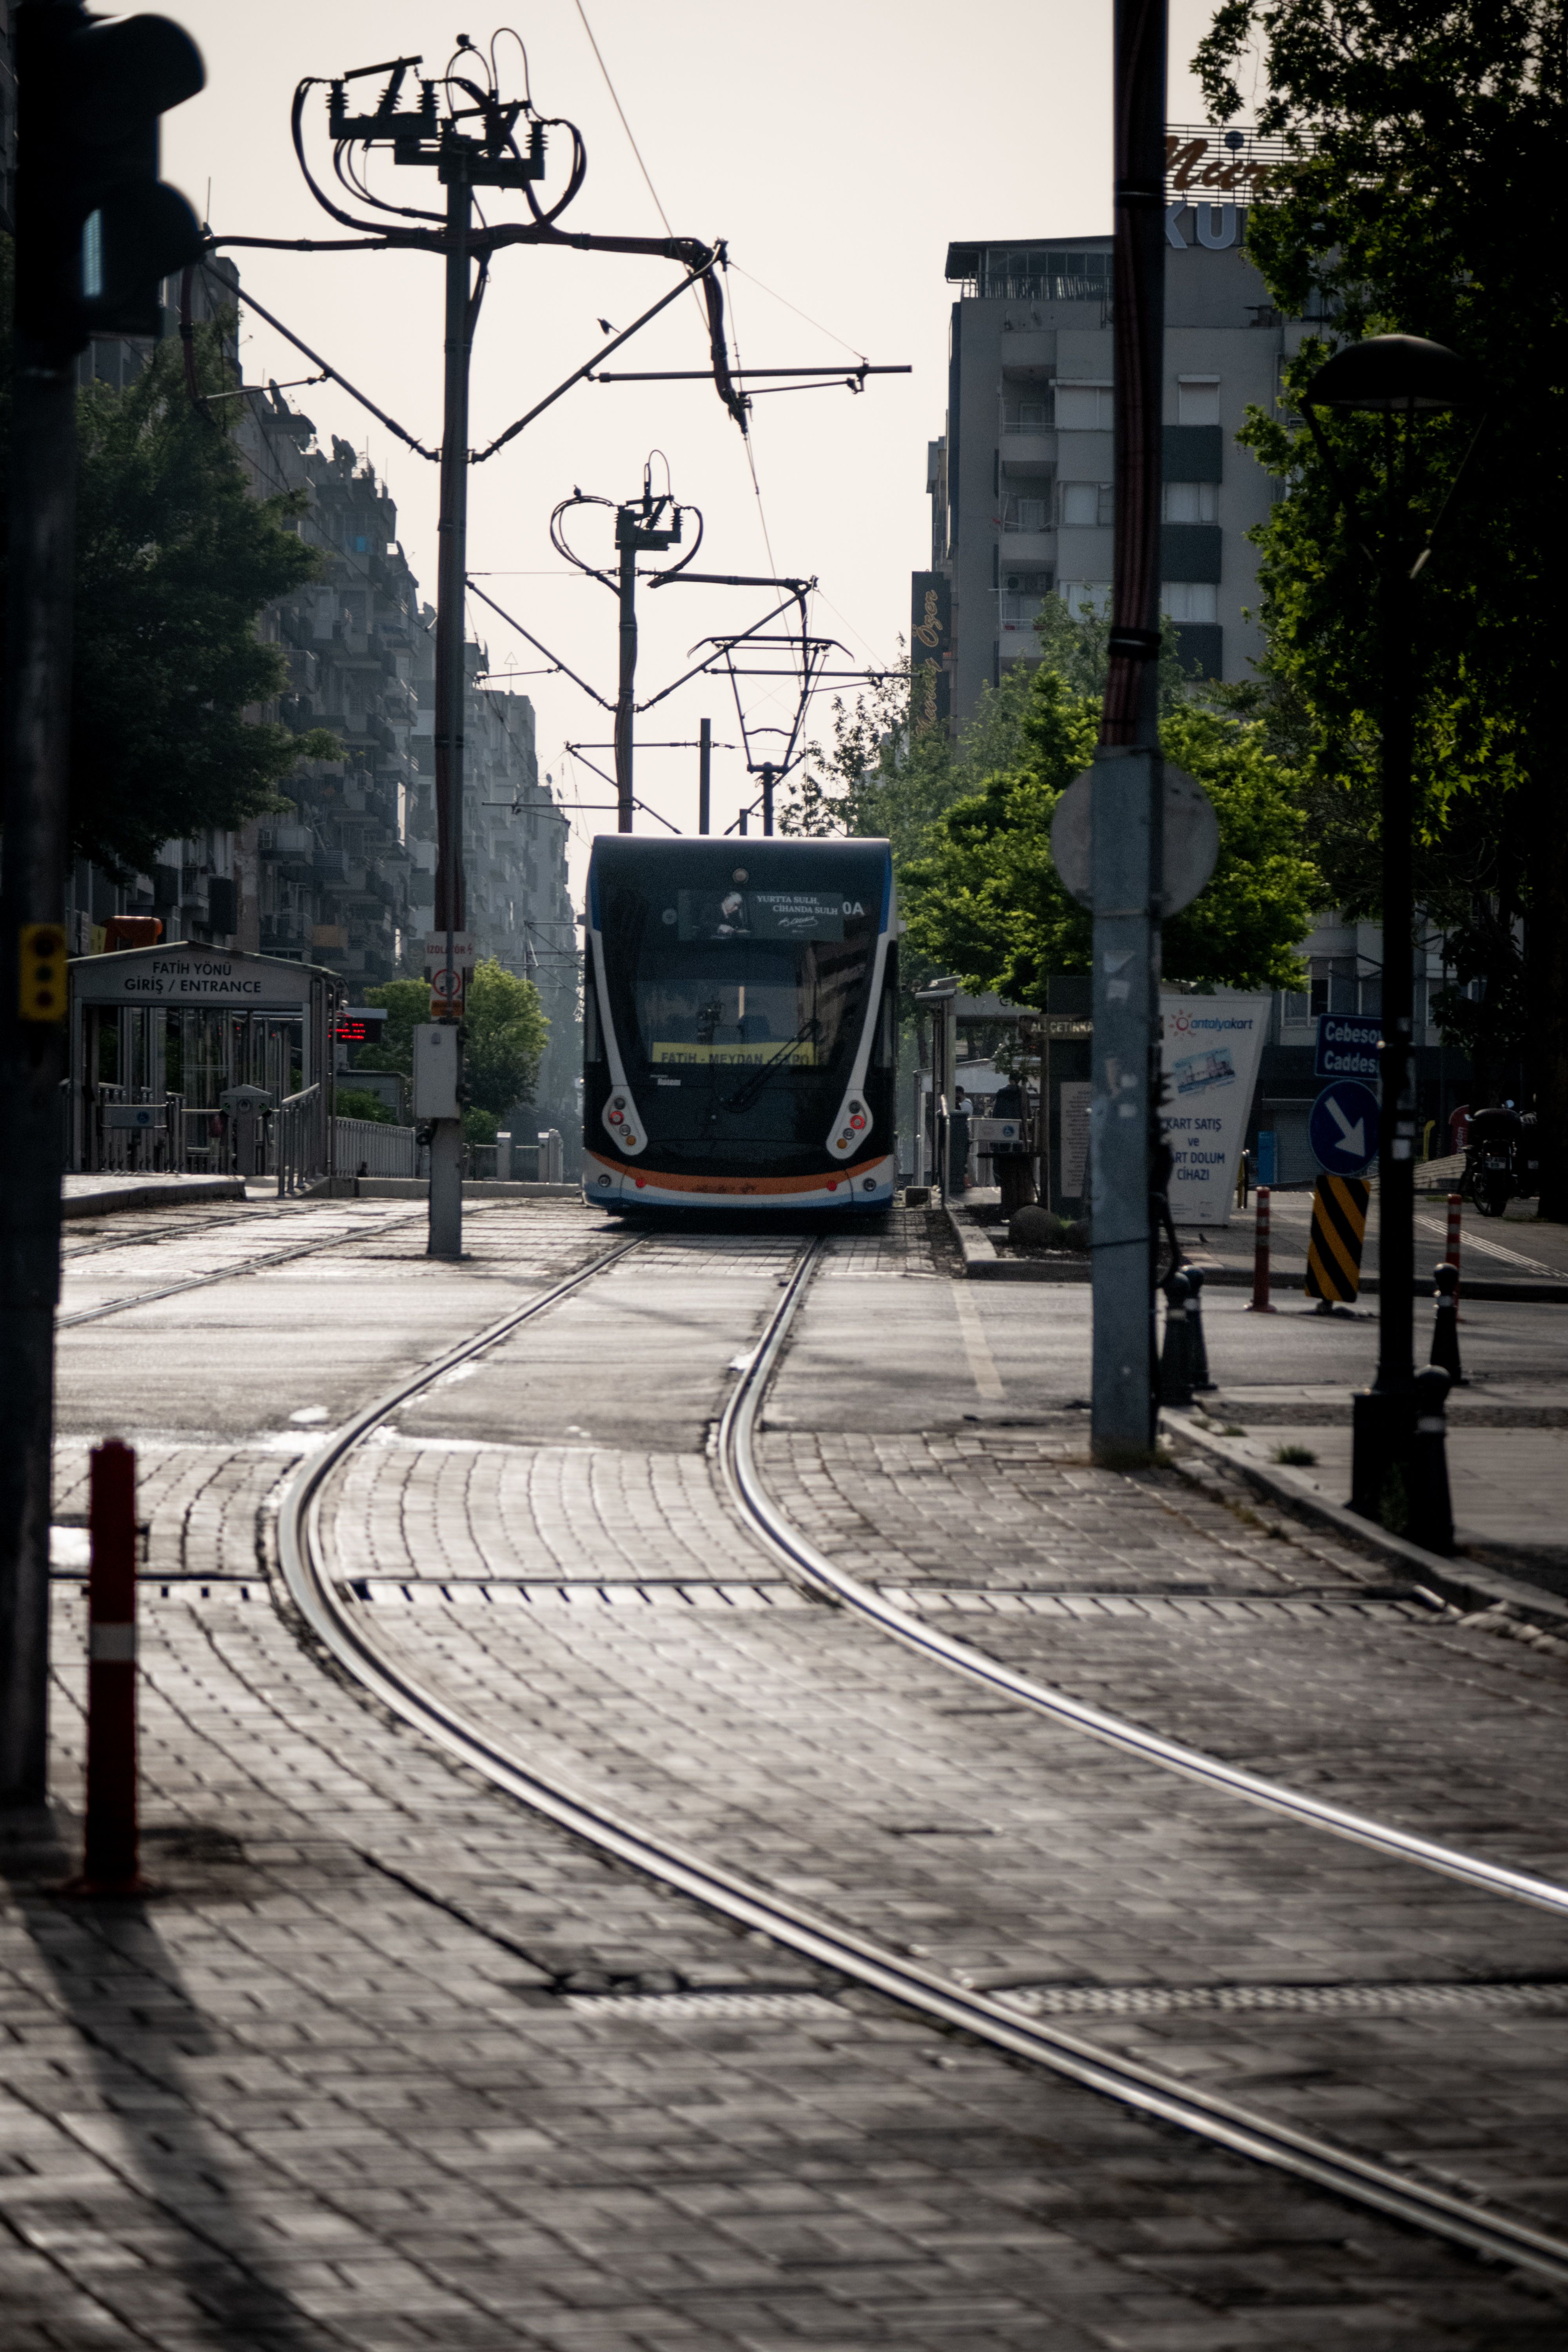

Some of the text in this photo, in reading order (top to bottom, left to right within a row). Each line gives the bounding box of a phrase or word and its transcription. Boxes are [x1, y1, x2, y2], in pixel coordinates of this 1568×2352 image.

[1165, 136, 1270, 191] Nur
[1165, 201, 1236, 249] KU
[912, 589, 944, 648] Özen
[772, 903, 838, 915] CİHANDA SULH
[152, 960, 232, 976] FATİH YÖNÜ
[125, 975, 163, 994] GİRİŞ
[180, 980, 261, 993] ENTRANCE
[1049, 1018, 1094, 1034] ÇETİNKA
[1191, 1018, 1254, 1032] antalyakart
[709, 1053, 763, 1064] MEYDAN
[1166, 1118, 1222, 1132] KART SATIŞ
[1188, 1137, 1200, 1147] ve
[1190, 1152, 1225, 1164] DOLUM
[1177, 1167, 1210, 1180] CİHAZI
